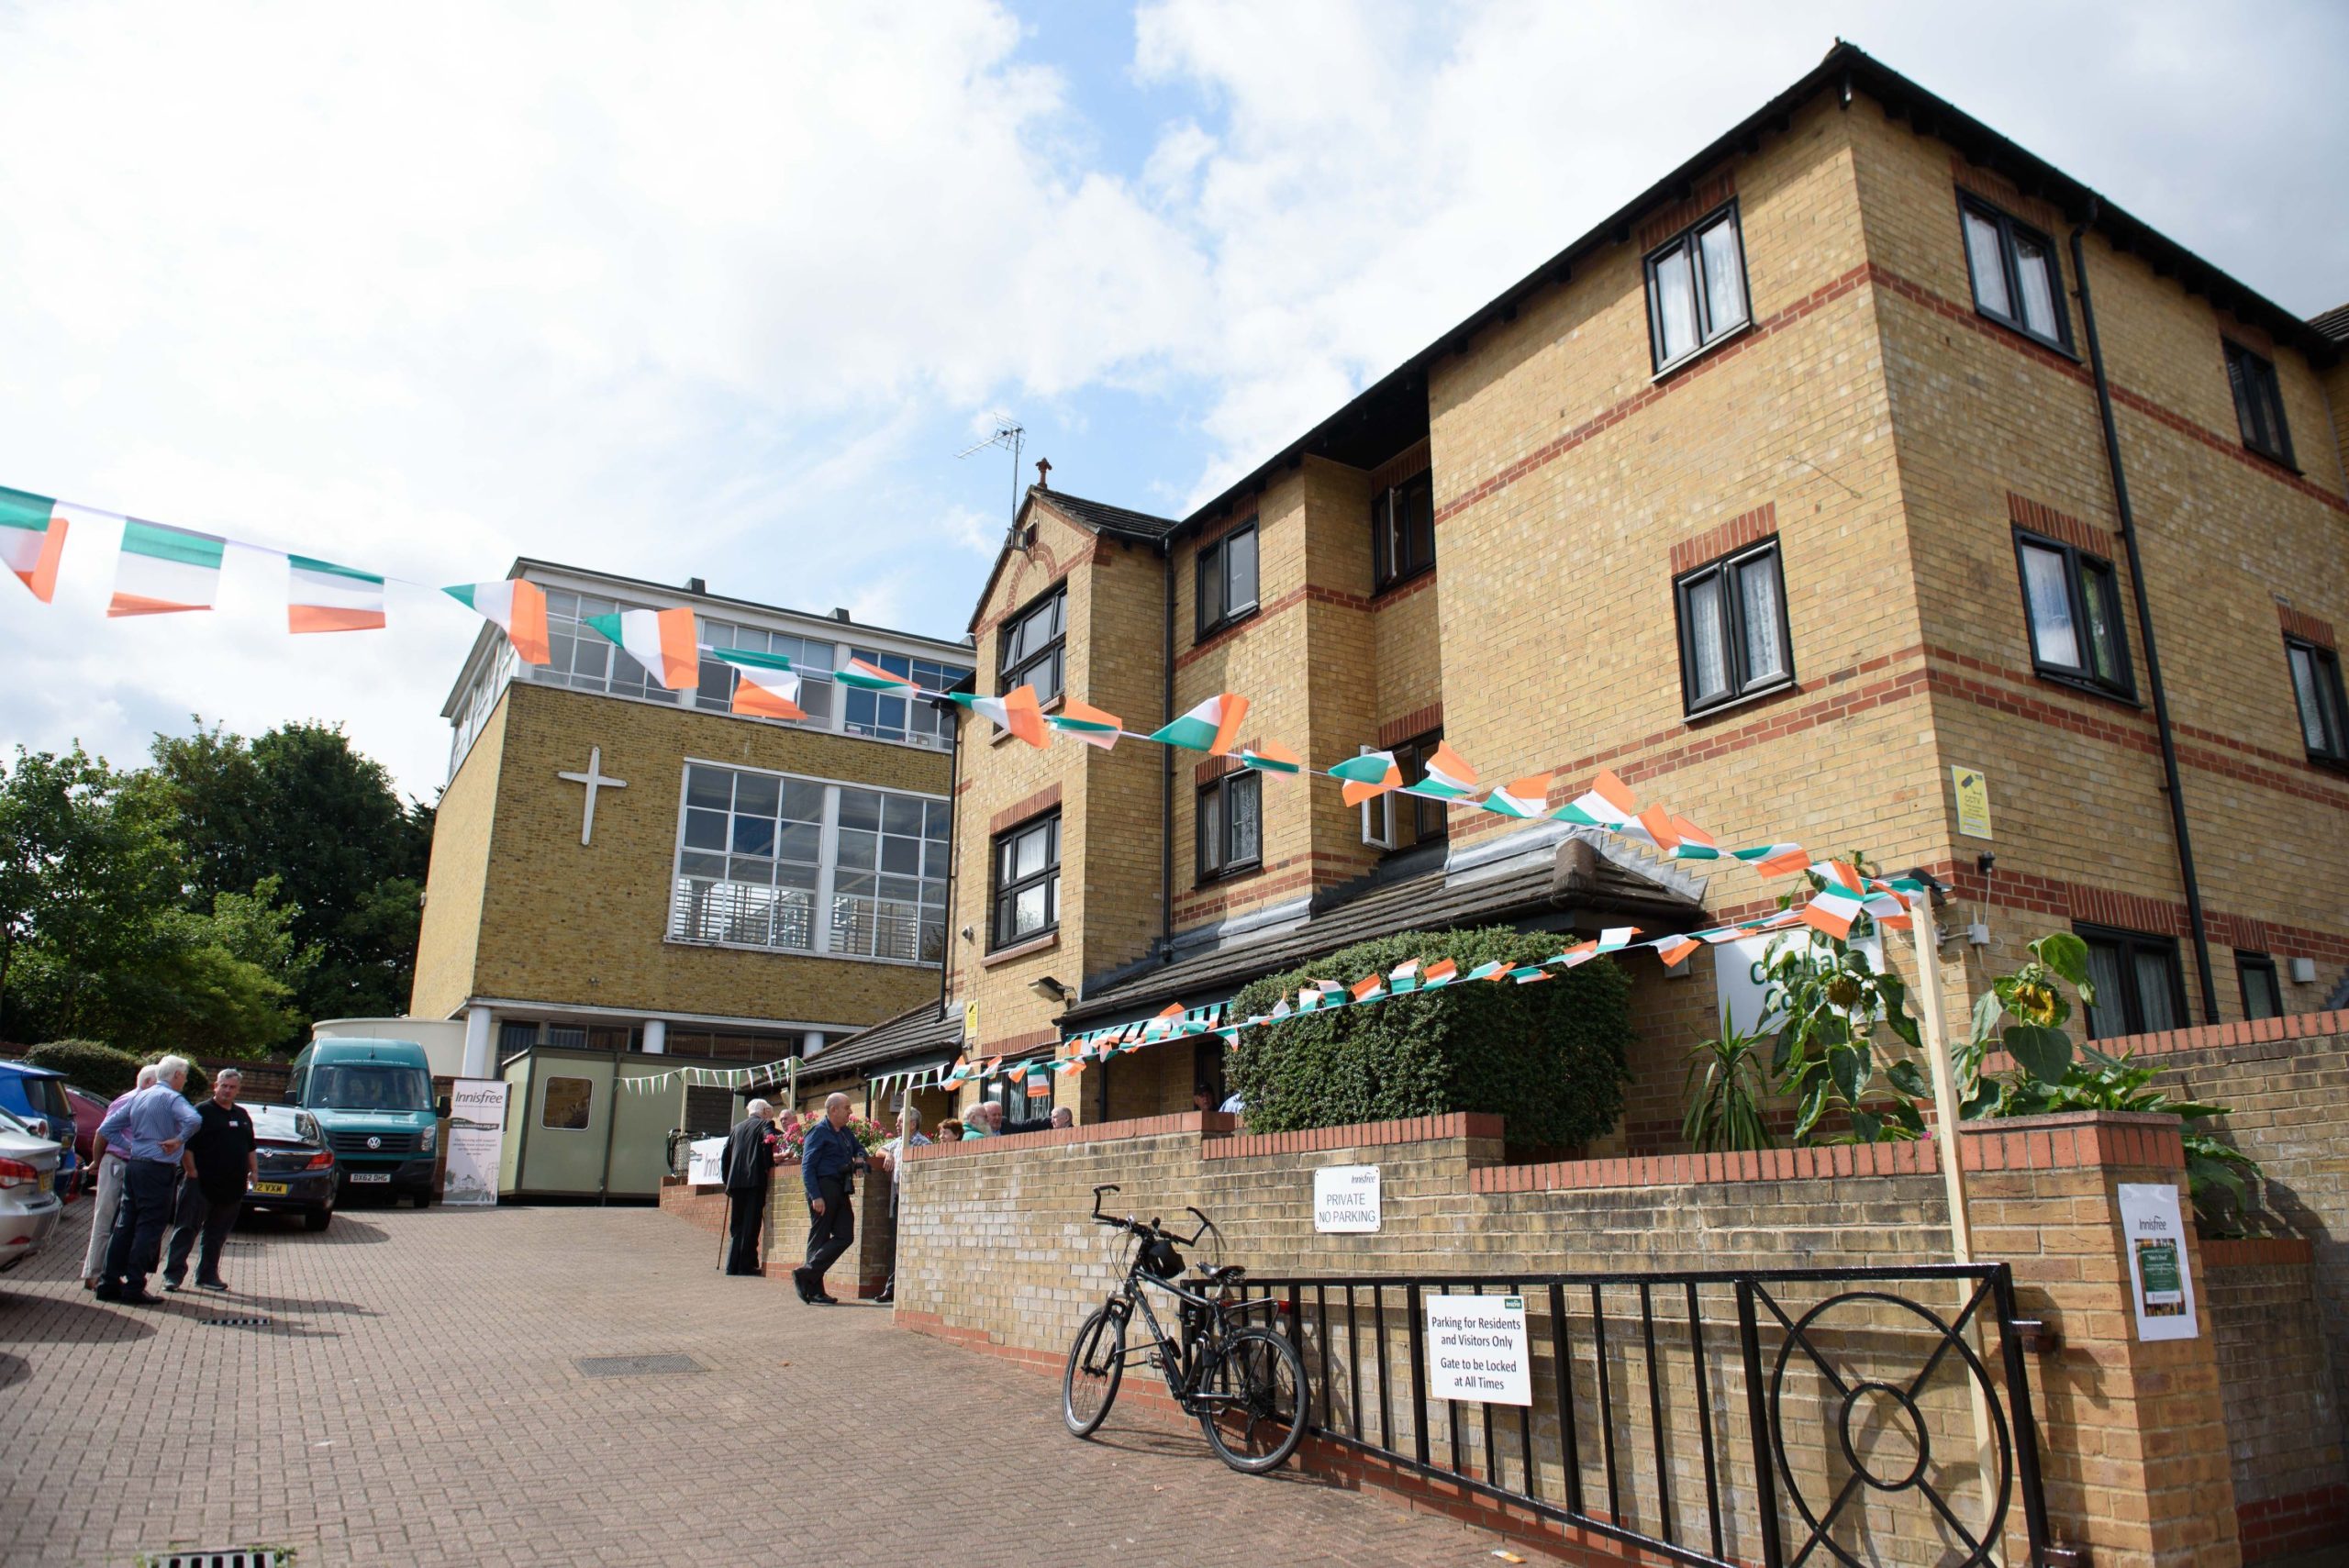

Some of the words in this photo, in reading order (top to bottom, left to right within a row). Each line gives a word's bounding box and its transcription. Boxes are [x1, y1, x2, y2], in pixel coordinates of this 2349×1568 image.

[455, 1089, 503, 1104] Innisfree
[1352, 1172, 1375, 1184] Innisfree
[1327, 1193, 1365, 1206] PRIVATE
[1319, 1211, 1331, 1223] NO
[1333, 1210, 1376, 1223] PARKING
[2139, 1216, 2166, 1230] Innisfree
[1431, 1317, 1463, 1330] Parking
[1464, 1317, 1476, 1329] for
[1478, 1318, 1520, 1329] Residents
[1442, 1334, 1456, 1345] and
[1458, 1334, 1490, 1346] Visitors
[1492, 1335, 1513, 1351] Only
[1441, 1358, 1460, 1370] Gate
[1462, 1360, 1471, 1370] to
[1473, 1359, 1484, 1370] be
[1486, 1360, 1517, 1373] Locked
[1454, 1377, 1463, 1387] at
[1465, 1376, 1476, 1387] All
[1478, 1377, 1505, 1390] Times
